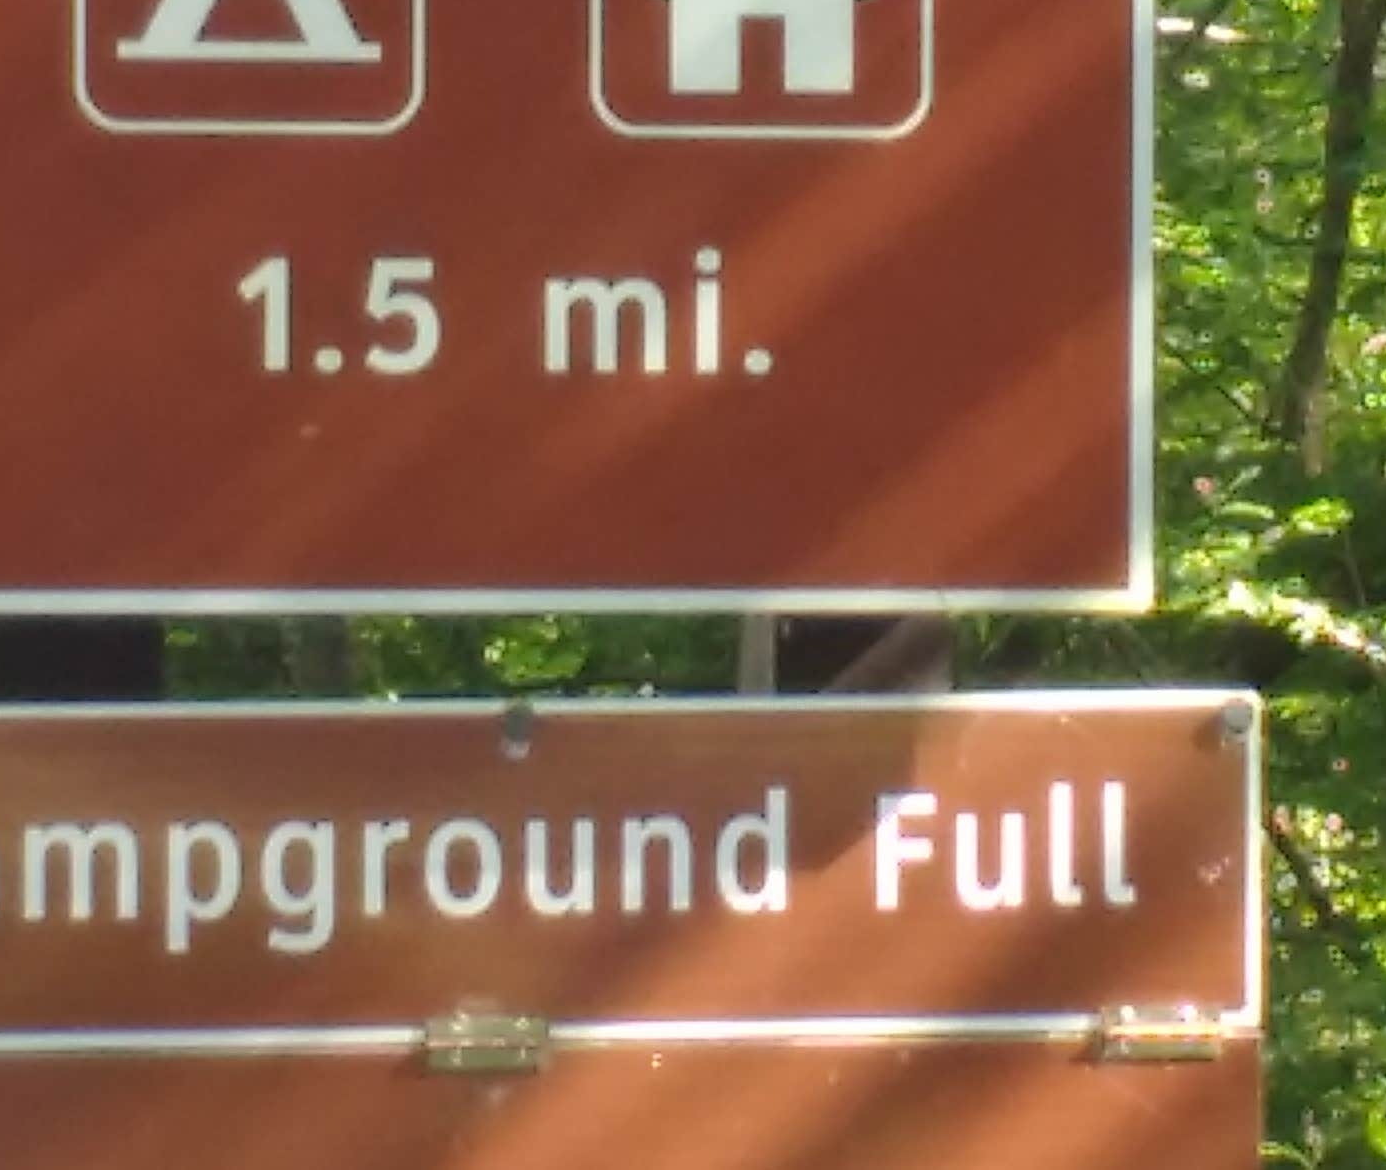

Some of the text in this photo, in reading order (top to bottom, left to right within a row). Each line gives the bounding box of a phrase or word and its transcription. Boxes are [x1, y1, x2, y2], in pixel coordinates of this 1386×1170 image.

[237, 247, 773, 376] 1.5 mi.
[872, 778, 1136, 915] Full
